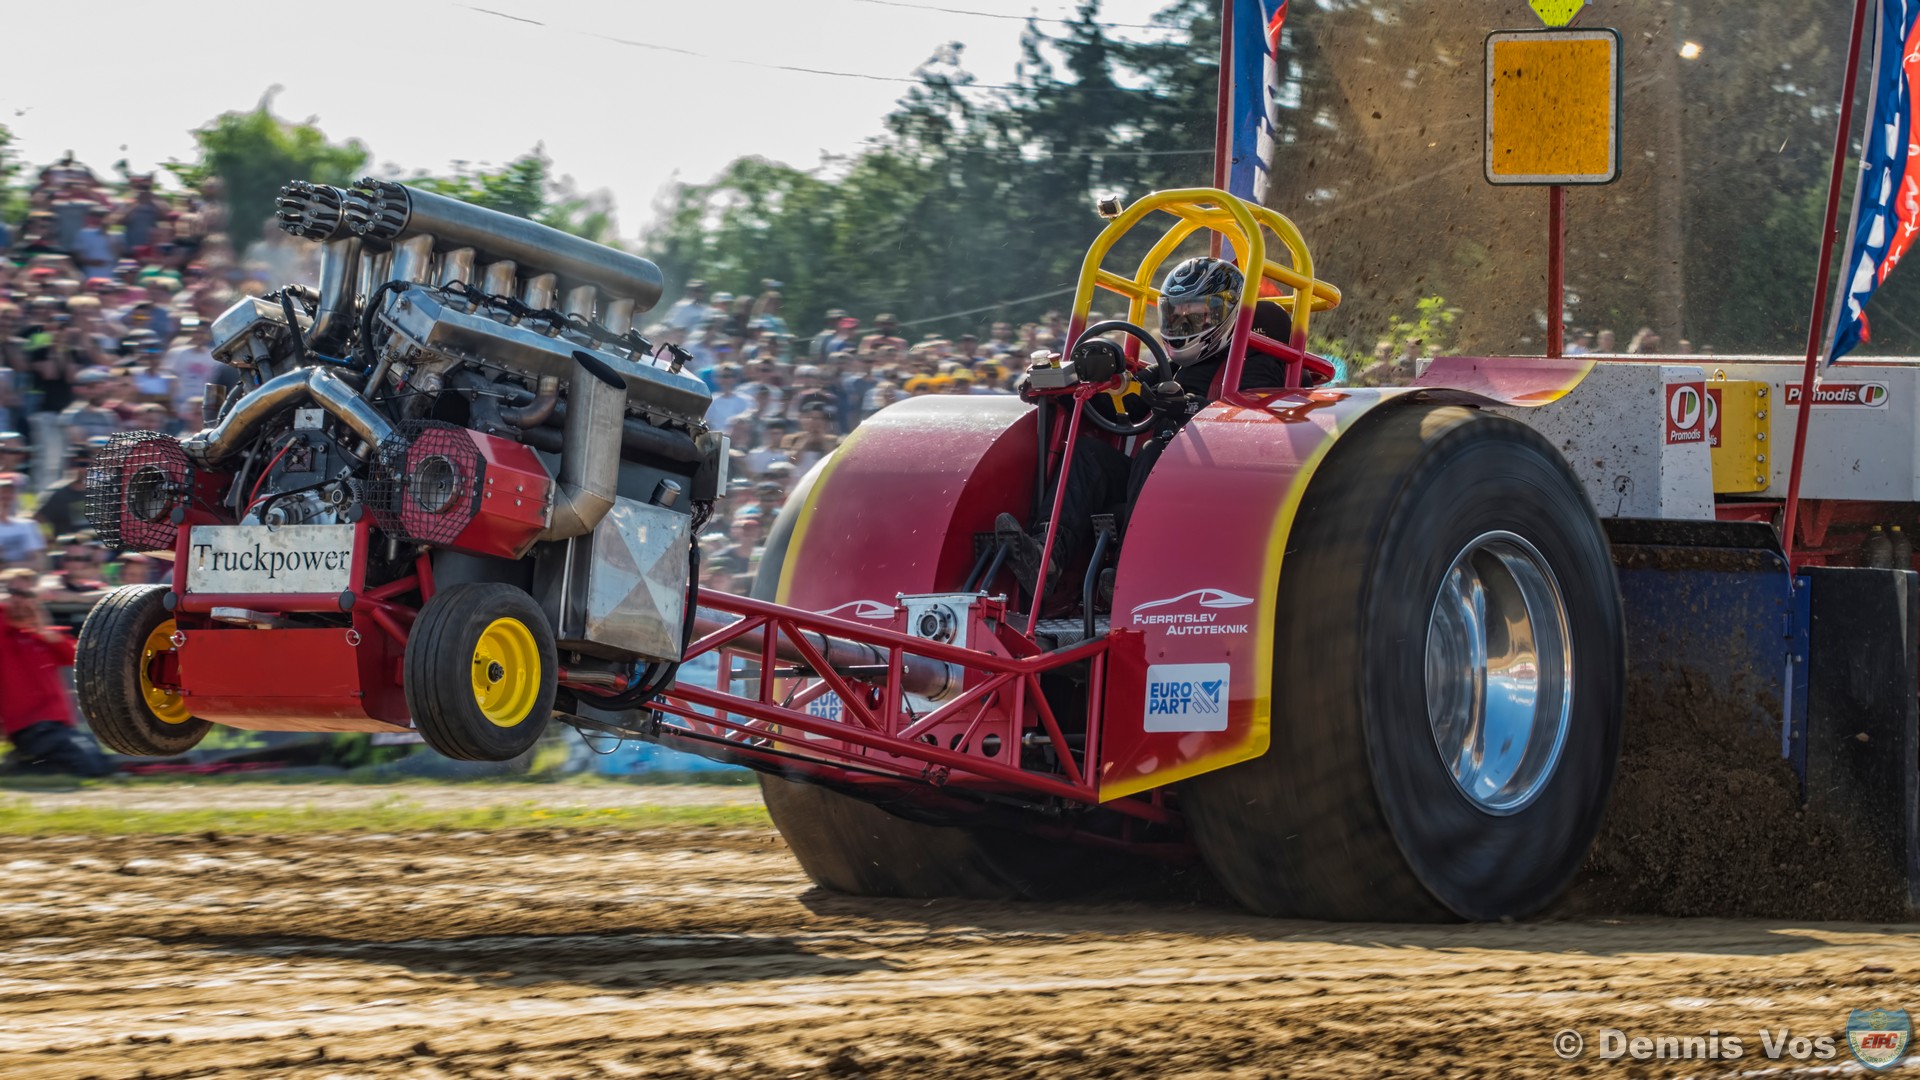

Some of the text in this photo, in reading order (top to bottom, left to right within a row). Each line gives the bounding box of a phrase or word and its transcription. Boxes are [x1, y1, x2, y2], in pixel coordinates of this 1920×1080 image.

[1788, 387, 1857, 402] Prmodis
[1671, 430, 1701, 441] Promodis
[193, 543, 350, 579] Truckpower
[1133, 613, 1217, 625] FJERRITSLEV
[1166, 624, 1248, 636] AUTOTEKNIK
[1150, 682, 1192, 699] EURO
[811, 691, 842, 707] UR
[1149, 698, 1191, 714] PART
[810, 706, 842, 720] PAR
